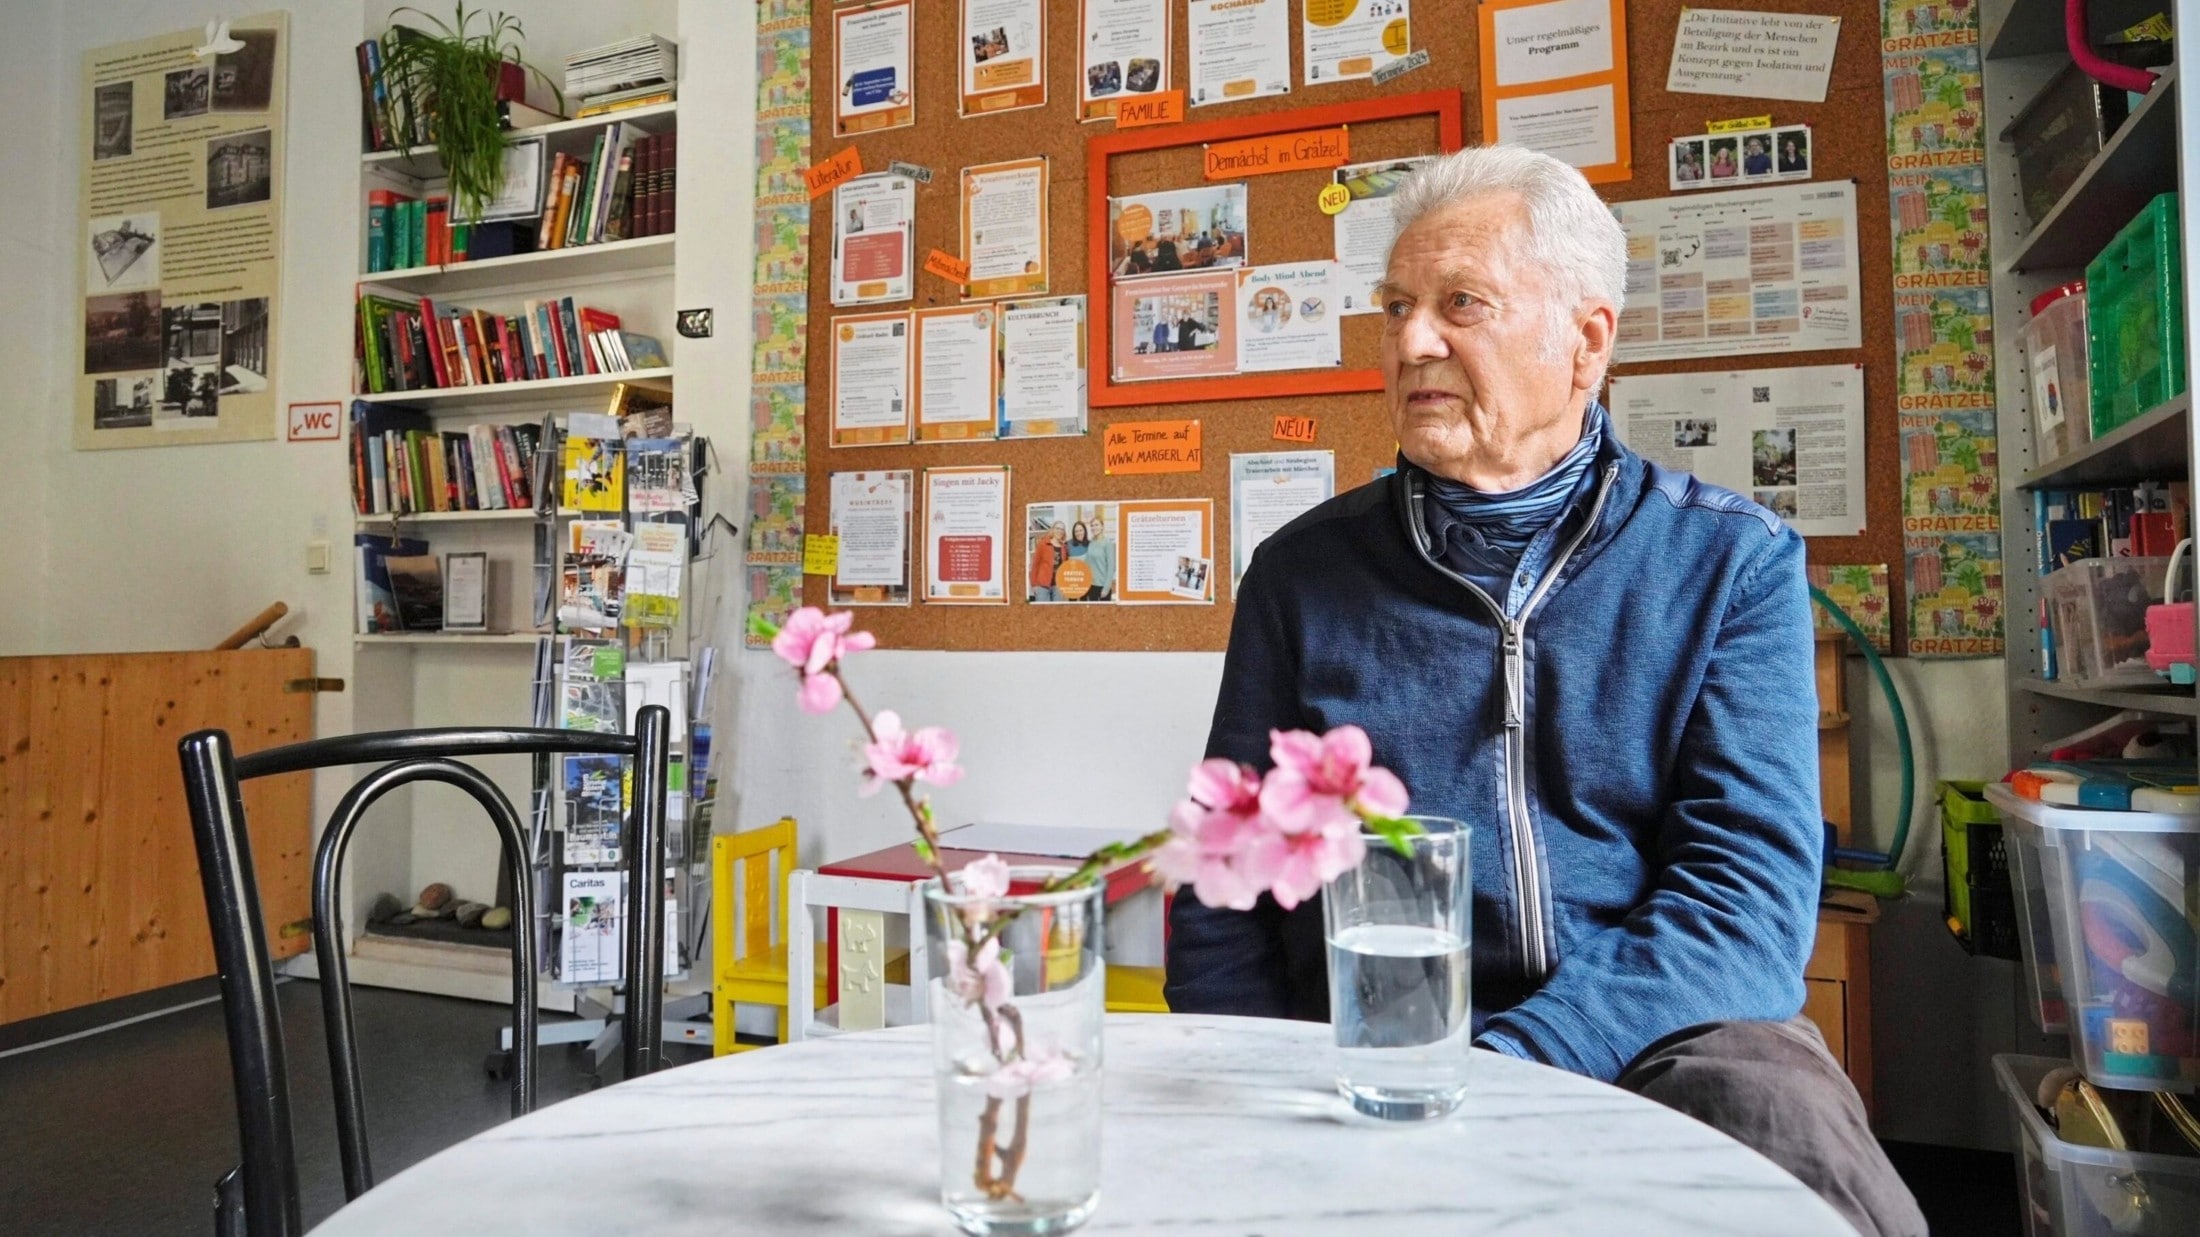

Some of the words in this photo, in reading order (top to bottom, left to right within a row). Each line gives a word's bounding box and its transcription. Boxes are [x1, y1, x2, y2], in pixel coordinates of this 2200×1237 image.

[1711, 14, 1758, 25] Initiative
[1761, 16, 1780, 27] lebt
[1805, 19, 1824, 30] der
[1507, 33, 1534, 45] Unser
[1536, 23, 1601, 41] regelmäßiges
[1683, 27, 1742, 41] Beteiligung
[1744, 29, 1762, 41] der
[1764, 31, 1818, 44] Menschen
[1528, 40, 1580, 55] Programm
[1696, 41, 1729, 53] Bezirk
[1731, 43, 1751, 54] und
[1768, 45, 1780, 55] ist
[1783, 46, 1800, 57] ein
[1406, 53, 1427, 68] 2024
[1677, 54, 1720, 68] Konzept
[1722, 58, 1754, 69] gegen
[1756, 58, 1802, 72] Isolation
[1805, 62, 1826, 73] und
[1120, 100, 1169, 121] FAMILIE
[1208, 144, 1270, 172] Demnächst
[1279, 149, 1291, 163] im
[1295, 134, 1343, 162] Grätzel
[810, 159, 853, 190] Literatur
[1322, 188, 1347, 209] NEU
[1251, 274, 1271, 284] Body
[1274, 271, 1296, 281] Mind
[1299, 268, 1326, 279] Abend
[304, 413, 333, 430] WC
[1108, 432, 1127, 446] Alle
[1132, 429, 1167, 444] Termine
[1174, 425, 1191, 441] auf
[934, 478, 960, 488] Singen
[962, 477, 976, 486] mit
[976, 476, 1000, 488] Jacky
[570, 878, 605, 889] Caritas
